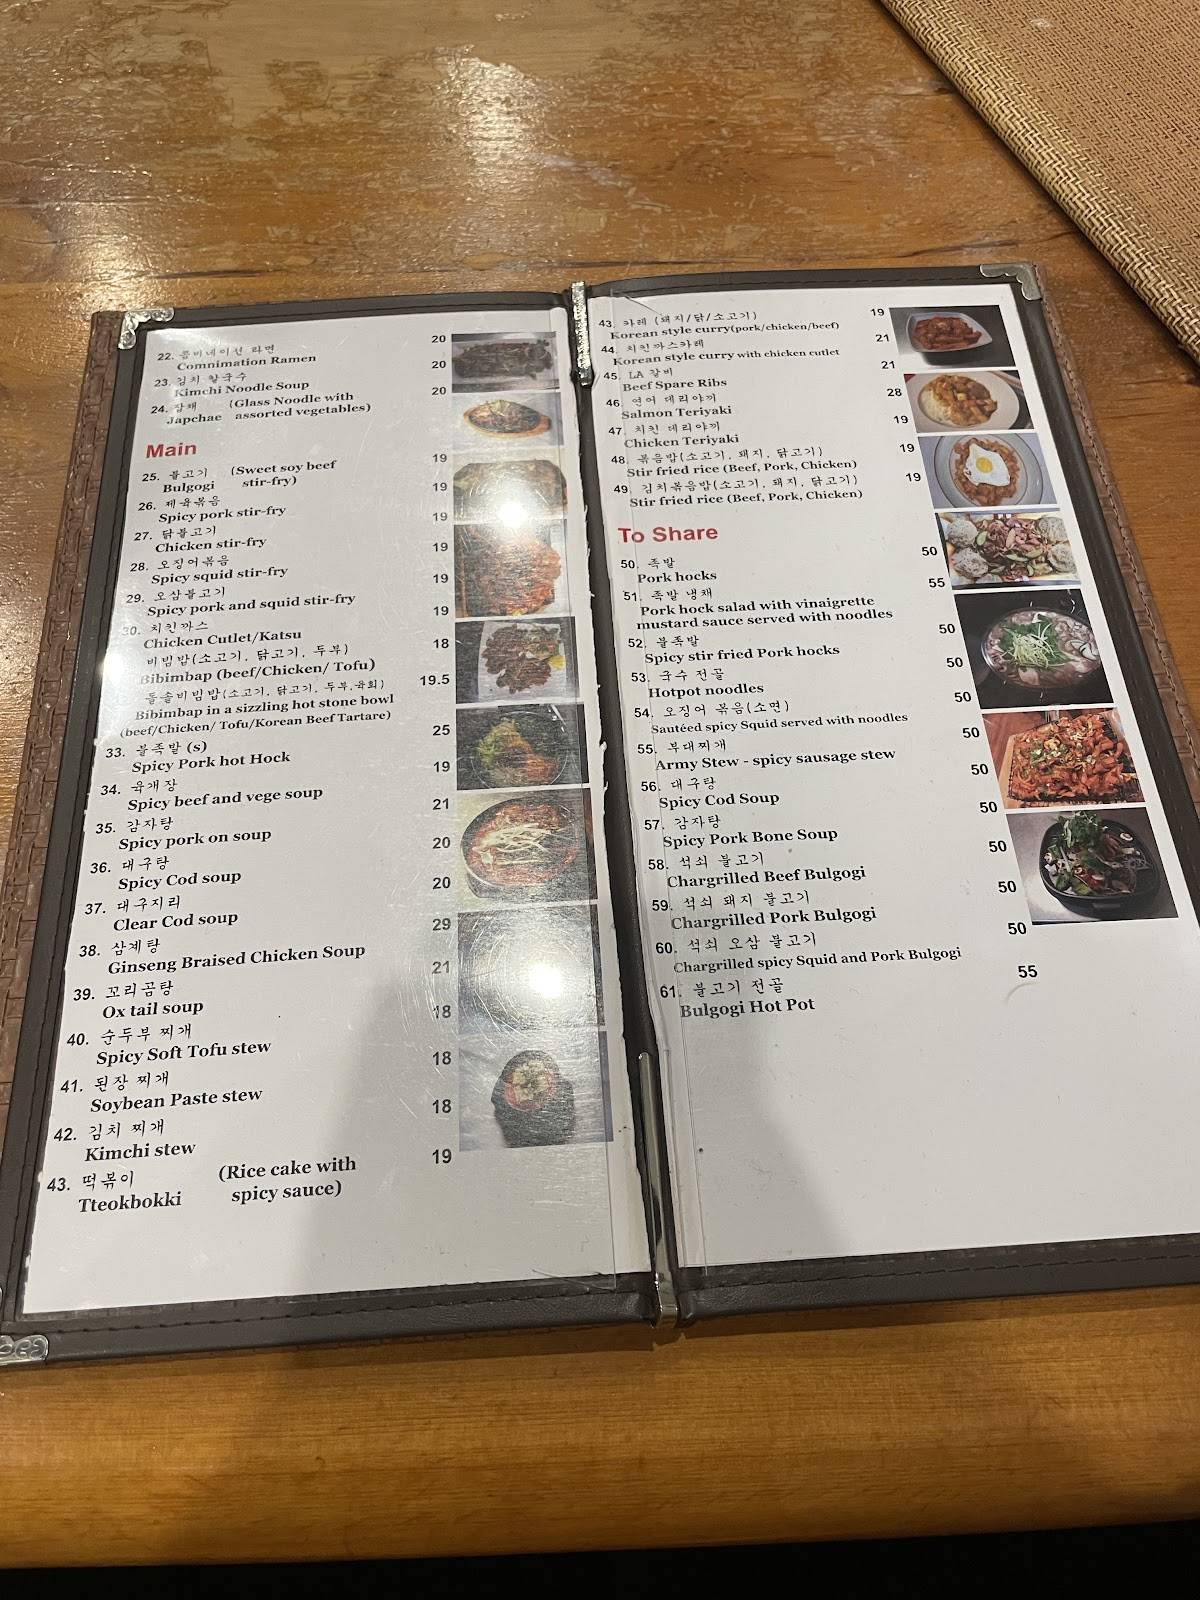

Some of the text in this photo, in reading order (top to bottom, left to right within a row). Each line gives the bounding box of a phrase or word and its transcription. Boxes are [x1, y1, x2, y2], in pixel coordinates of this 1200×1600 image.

[870, 308, 885, 317] 19
[610, 321, 840, 340] Korean style curry(pork/chicken/beef)
[431, 334, 446, 344] 20
[875, 333, 890, 343] 21
[176, 356, 316, 371] Comnimation Ramen
[431, 360, 447, 369] 20
[881, 360, 895, 370] 21
[431, 386, 447, 396] 20
[622, 378, 727, 392] Beef Spare Ribs
[886, 388, 903, 397] 28
[229, 392, 354, 409] (Glass Noodle with
[235, 403, 371, 420] assorted vegetables)
[893, 415, 909, 424] 19
[623, 434, 739, 449] Chicken Teriyaki
[899, 443, 915, 453] 19
[145, 442, 197, 459] Main
[432, 453, 448, 463] 19
[231, 459, 337, 476] (Sweet soy beef
[242, 475, 297, 487] stir-fry)
[905, 472, 922, 482] 19
[163, 480, 215, 494] Bulgogi
[432, 482, 448, 492] 19
[158, 505, 286, 525] Spicy pork stir-fry
[432, 512, 448, 522] 19
[617, 526, 718, 544] To Share
[155, 537, 267, 553] Chicken stir-fry
[432, 542, 449, 552] 19
[921, 546, 938, 557] 50
[433, 573, 449, 584] 19
[637, 570, 717, 584] Pork hocks
[928, 577, 946, 588] 55
[433, 605, 449, 617] 19
[640, 597, 876, 616] Pork hock salad with vinaigrette
[938, 623, 956, 634] 50
[143, 631, 302, 649] Chicken Cutlet/Katsu
[433, 638, 450, 649] 18
[946, 656, 964, 668] 50
[419, 673, 450, 686] 19.5
[648, 683, 764, 700] Hotpot noodles
[954, 691, 972, 703] 50
[432, 724, 451, 736] 25
[962, 726, 980, 739] 50
[131, 751, 291, 775] Spicy Pork hot Hock
[433, 760, 451, 773] 19
[655, 760, 698, 772] Army
[701, 757, 740, 769] Stew
[752, 753, 792, 769] spicy
[795, 753, 857, 764] sausage
[860, 750, 895, 760] stew
[970, 763, 989, 776] 50
[127, 789, 323, 813] Spicy beef and vege soup
[432, 797, 449, 811] 21
[659, 793, 780, 811] Spicy Cod Soup
[979, 801, 998, 814] 50
[118, 831, 272, 852] Spicy pork on soup
[432, 836, 451, 850] 20
[662, 828, 838, 850] Spicy Pork Bone Soup
[988, 840, 1007, 853] 50
[432, 876, 451, 890] 20
[666, 865, 866, 889] Chargrilled Beef Bulgogi
[998, 880, 1017, 894] 50
[432, 917, 452, 932] 29
[1007, 921, 1027, 935] 50
[108, 945, 366, 975] Ginseng Braised Chicken Soup
[431, 960, 450, 975] 21
[1017, 964, 1038, 979] 55
[102, 1001, 204, 1019] Ox tail soup
[432, 1004, 452, 1019] 18
[679, 998, 816, 1019] Bulgogi Hot Pot
[96, 1042, 272, 1068] Spicy Soft Tofu stew
[432, 1050, 452, 1066] 18
[90, 1090, 263, 1114] Soybean Paste stew
[432, 1098, 452, 1114] 18
[84, 1142, 196, 1162] Kimchi stew
[432, 1148, 452, 1165] 19
[218, 1155, 356, 1183] (Rice cake with
[231, 1179, 342, 1205] spicy sauce)
[78, 1190, 182, 1213] Tteokbokki
